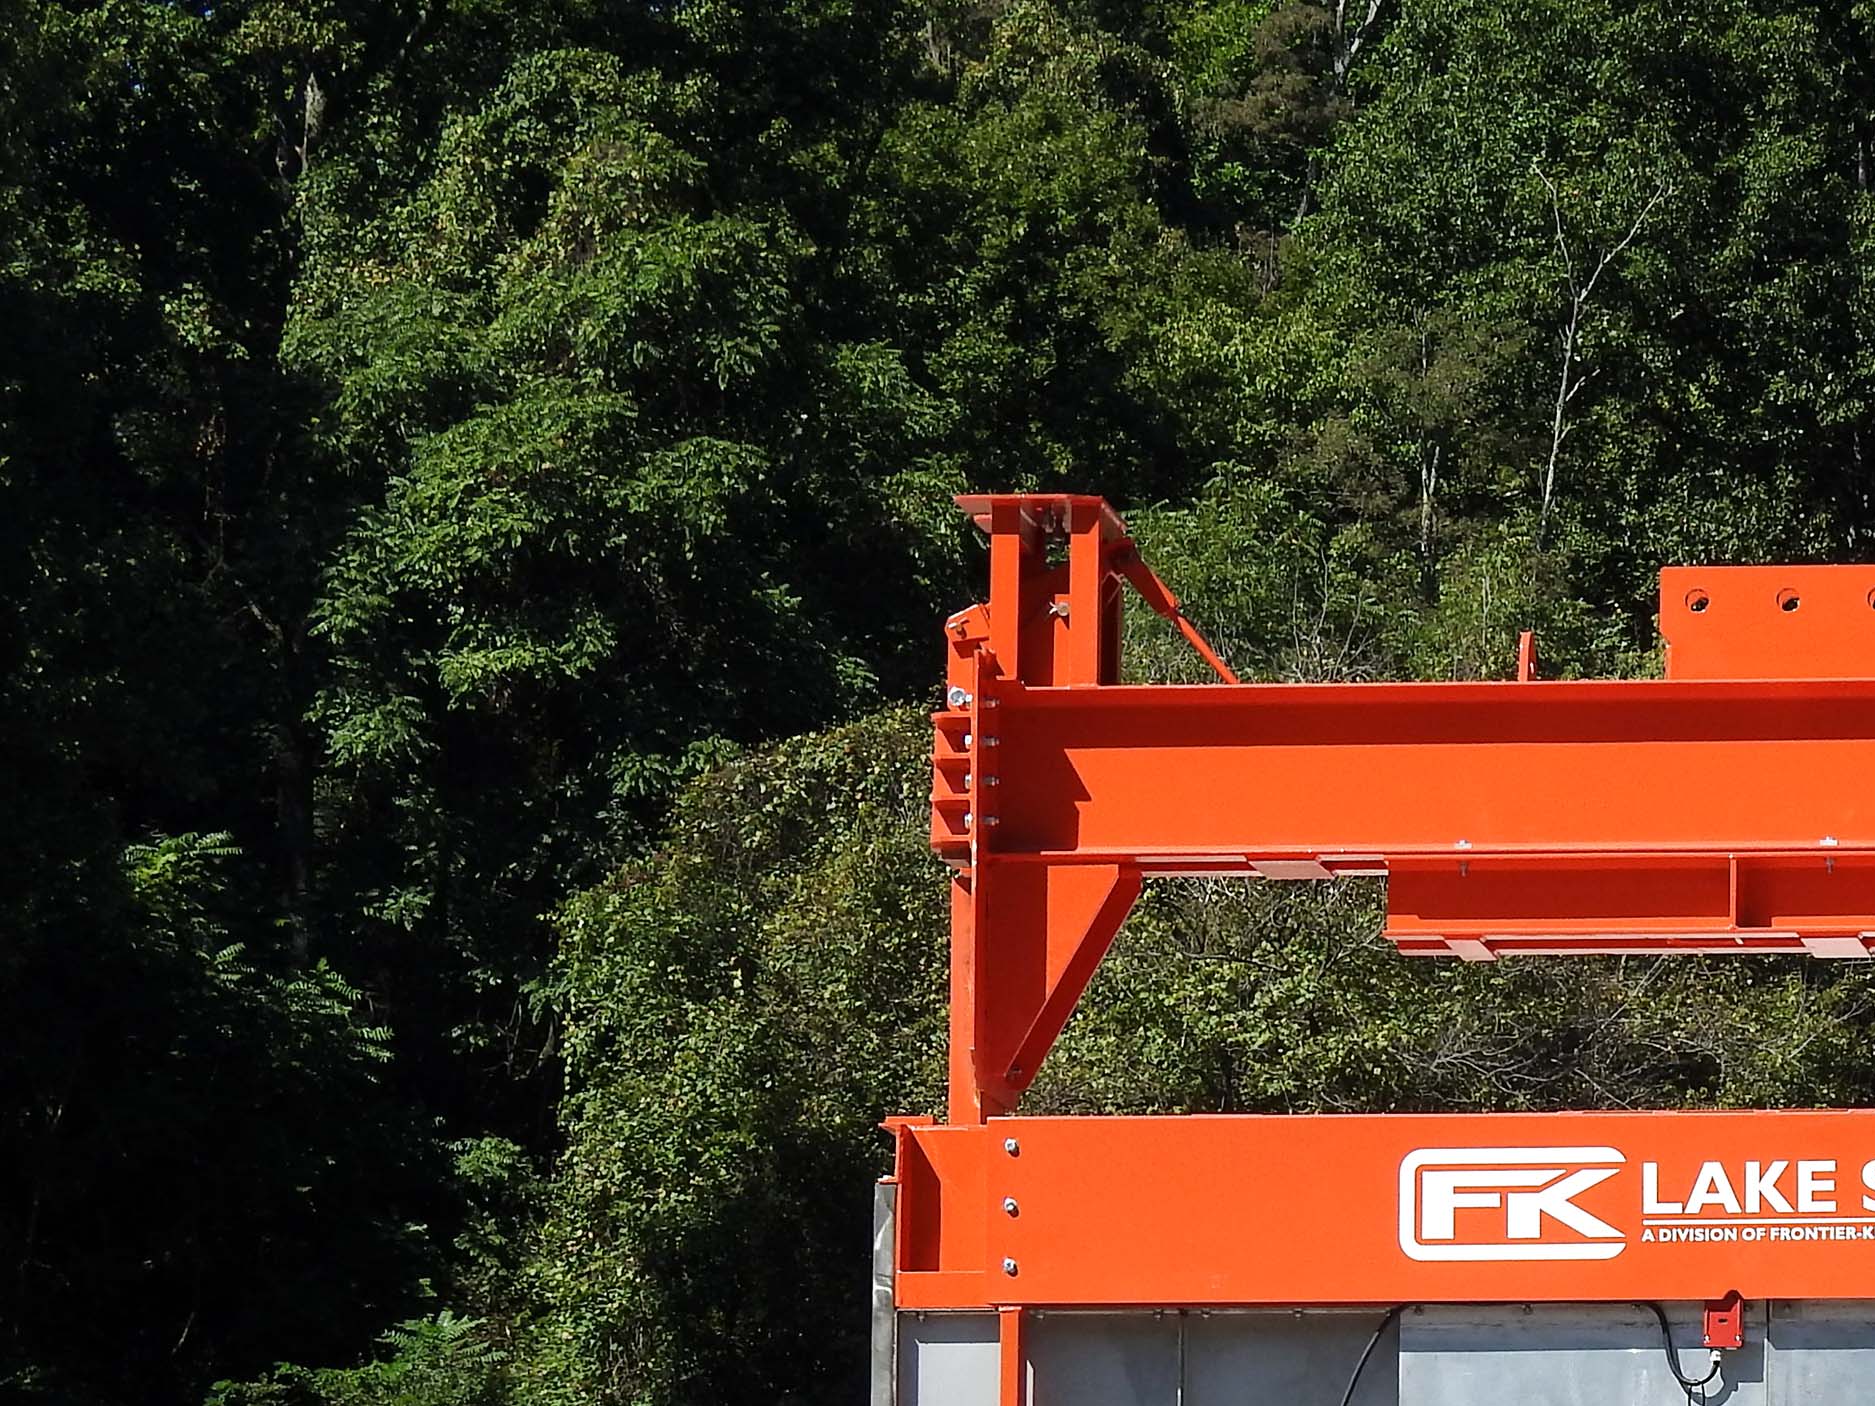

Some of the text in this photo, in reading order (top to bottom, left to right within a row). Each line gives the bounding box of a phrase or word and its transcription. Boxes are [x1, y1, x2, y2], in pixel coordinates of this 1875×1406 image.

[1641, 1160, 1838, 1214] LAKE
[1641, 1228, 1655, 1243] A
[1659, 1227, 1738, 1243] DIVISION
[1741, 1226, 1767, 1242] OF
